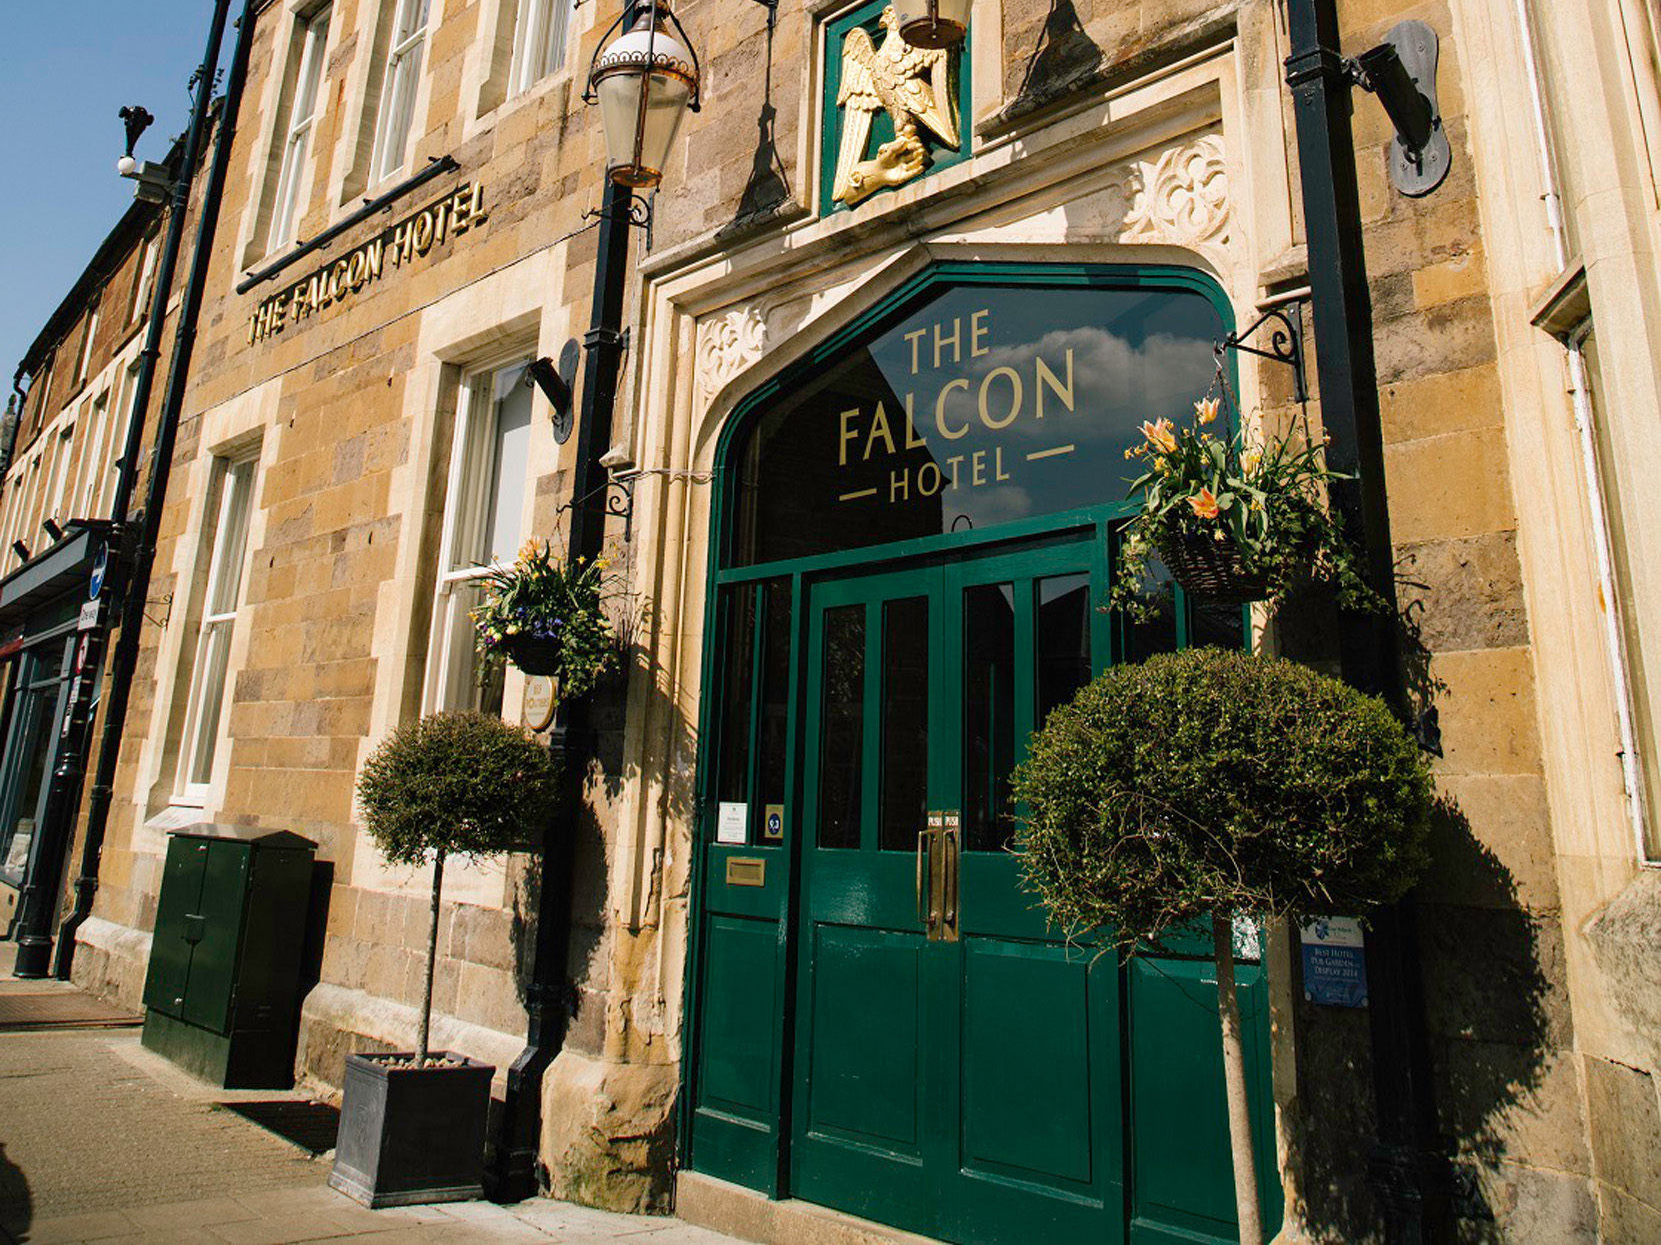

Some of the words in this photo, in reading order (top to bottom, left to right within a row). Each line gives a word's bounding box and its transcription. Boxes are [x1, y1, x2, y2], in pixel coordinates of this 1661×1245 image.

[247, 294, 286, 346] THE
[291, 239, 383, 320] FALCON
[392, 182, 487, 267] HOTEL
[904, 309, 989, 374] THE
[839, 348, 1075, 466] FALCON
[889, 446, 1010, 503] HOTEL
[1331, 949, 1354, 958] HOTEL
